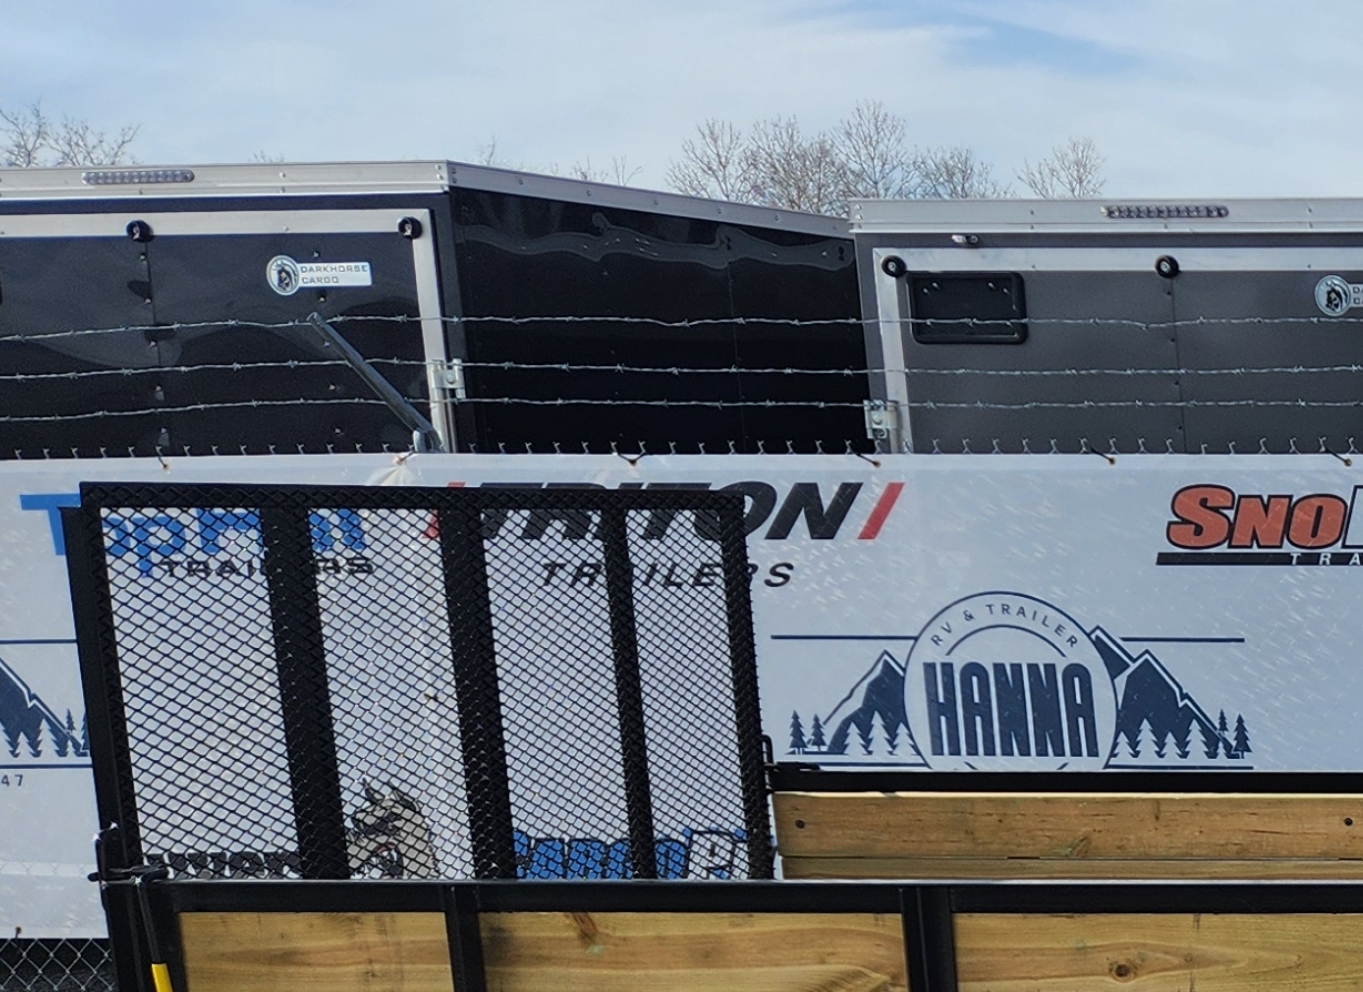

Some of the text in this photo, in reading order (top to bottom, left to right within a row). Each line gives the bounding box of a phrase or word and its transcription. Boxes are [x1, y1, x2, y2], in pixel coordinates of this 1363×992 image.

[300, 265, 368, 274] DARKHORSE
[301, 276, 340, 284] CARGO
[478, 481, 864, 540] RTON
[542, 562, 795, 588] TRILES
[930, 603, 1079, 648] RV & TRAILER
[922, 661, 1100, 758] HANNA
